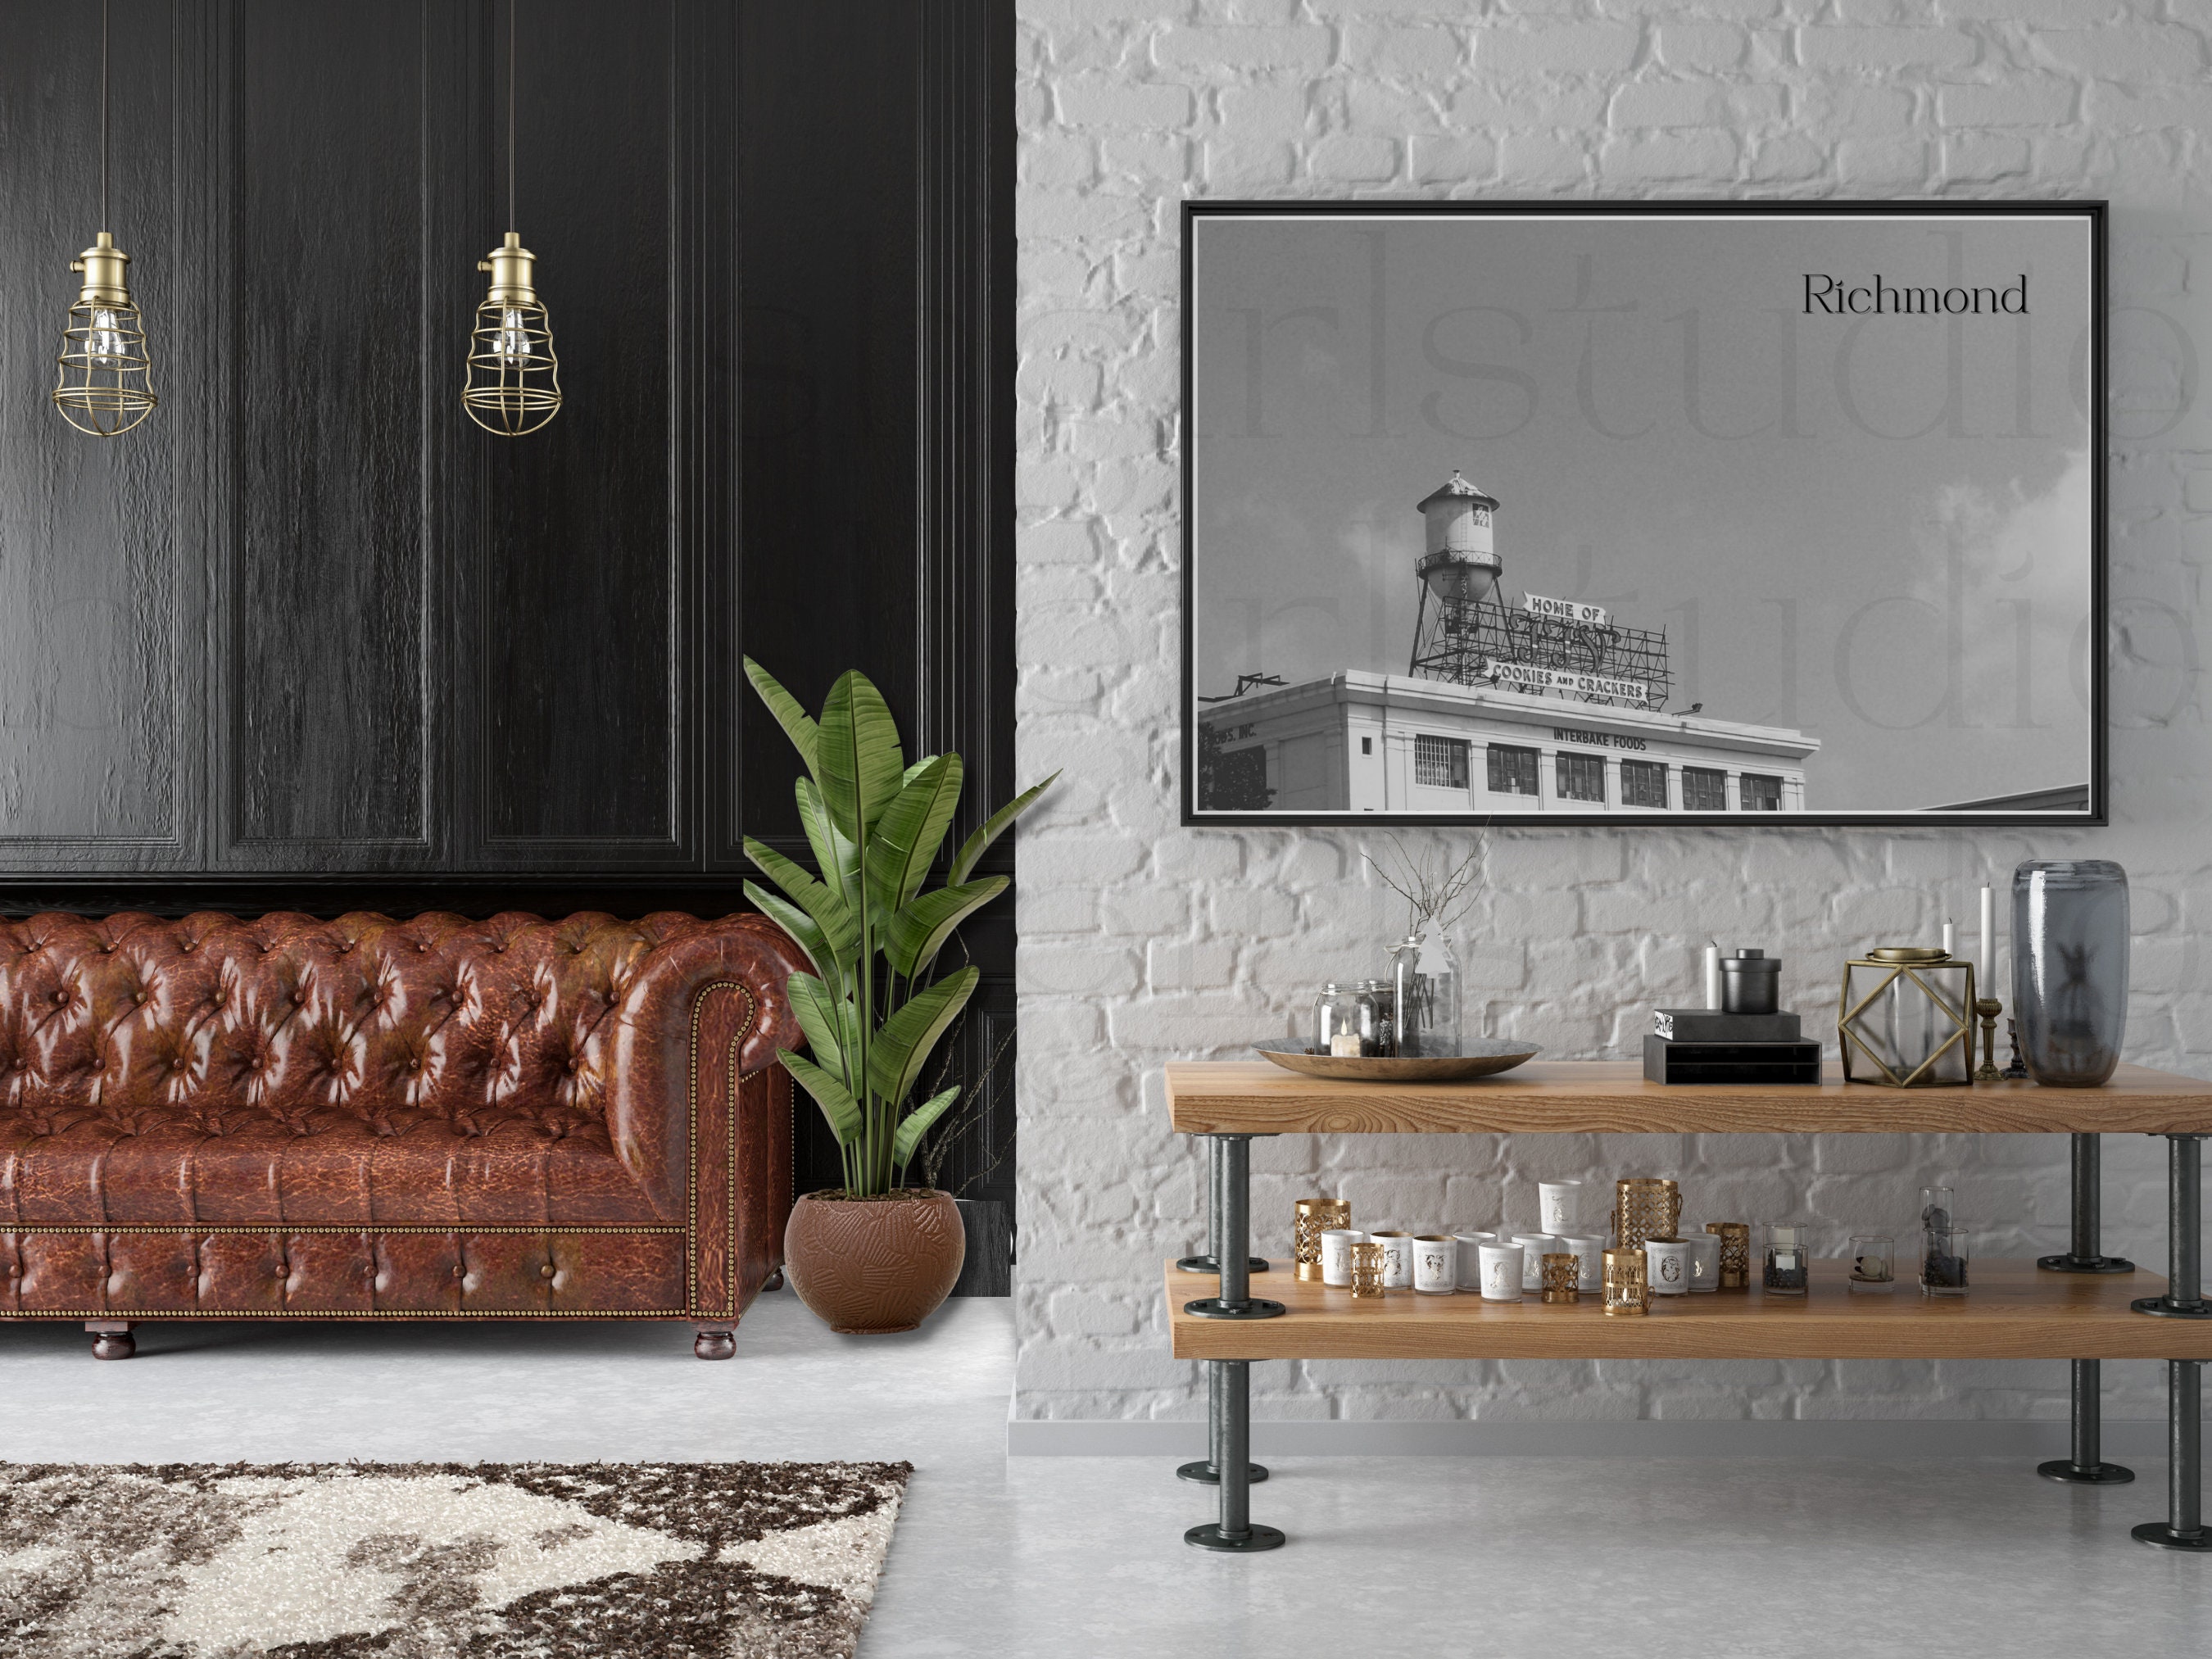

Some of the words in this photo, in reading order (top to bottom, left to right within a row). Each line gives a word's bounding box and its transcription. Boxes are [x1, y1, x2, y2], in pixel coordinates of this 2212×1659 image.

[1802, 274, 2031, 315] Richmond
[1532, 597, 1573, 616] HOME
[1581, 606, 1600, 621] OF
[1493, 664, 1552, 685] COOKIES
[1557, 675, 1574, 686] AND
[1577, 677, 1643, 698] CRACKERS
[1553, 728, 1609, 746] INTERBAKE
[1613, 735, 1647, 750] FOODS
